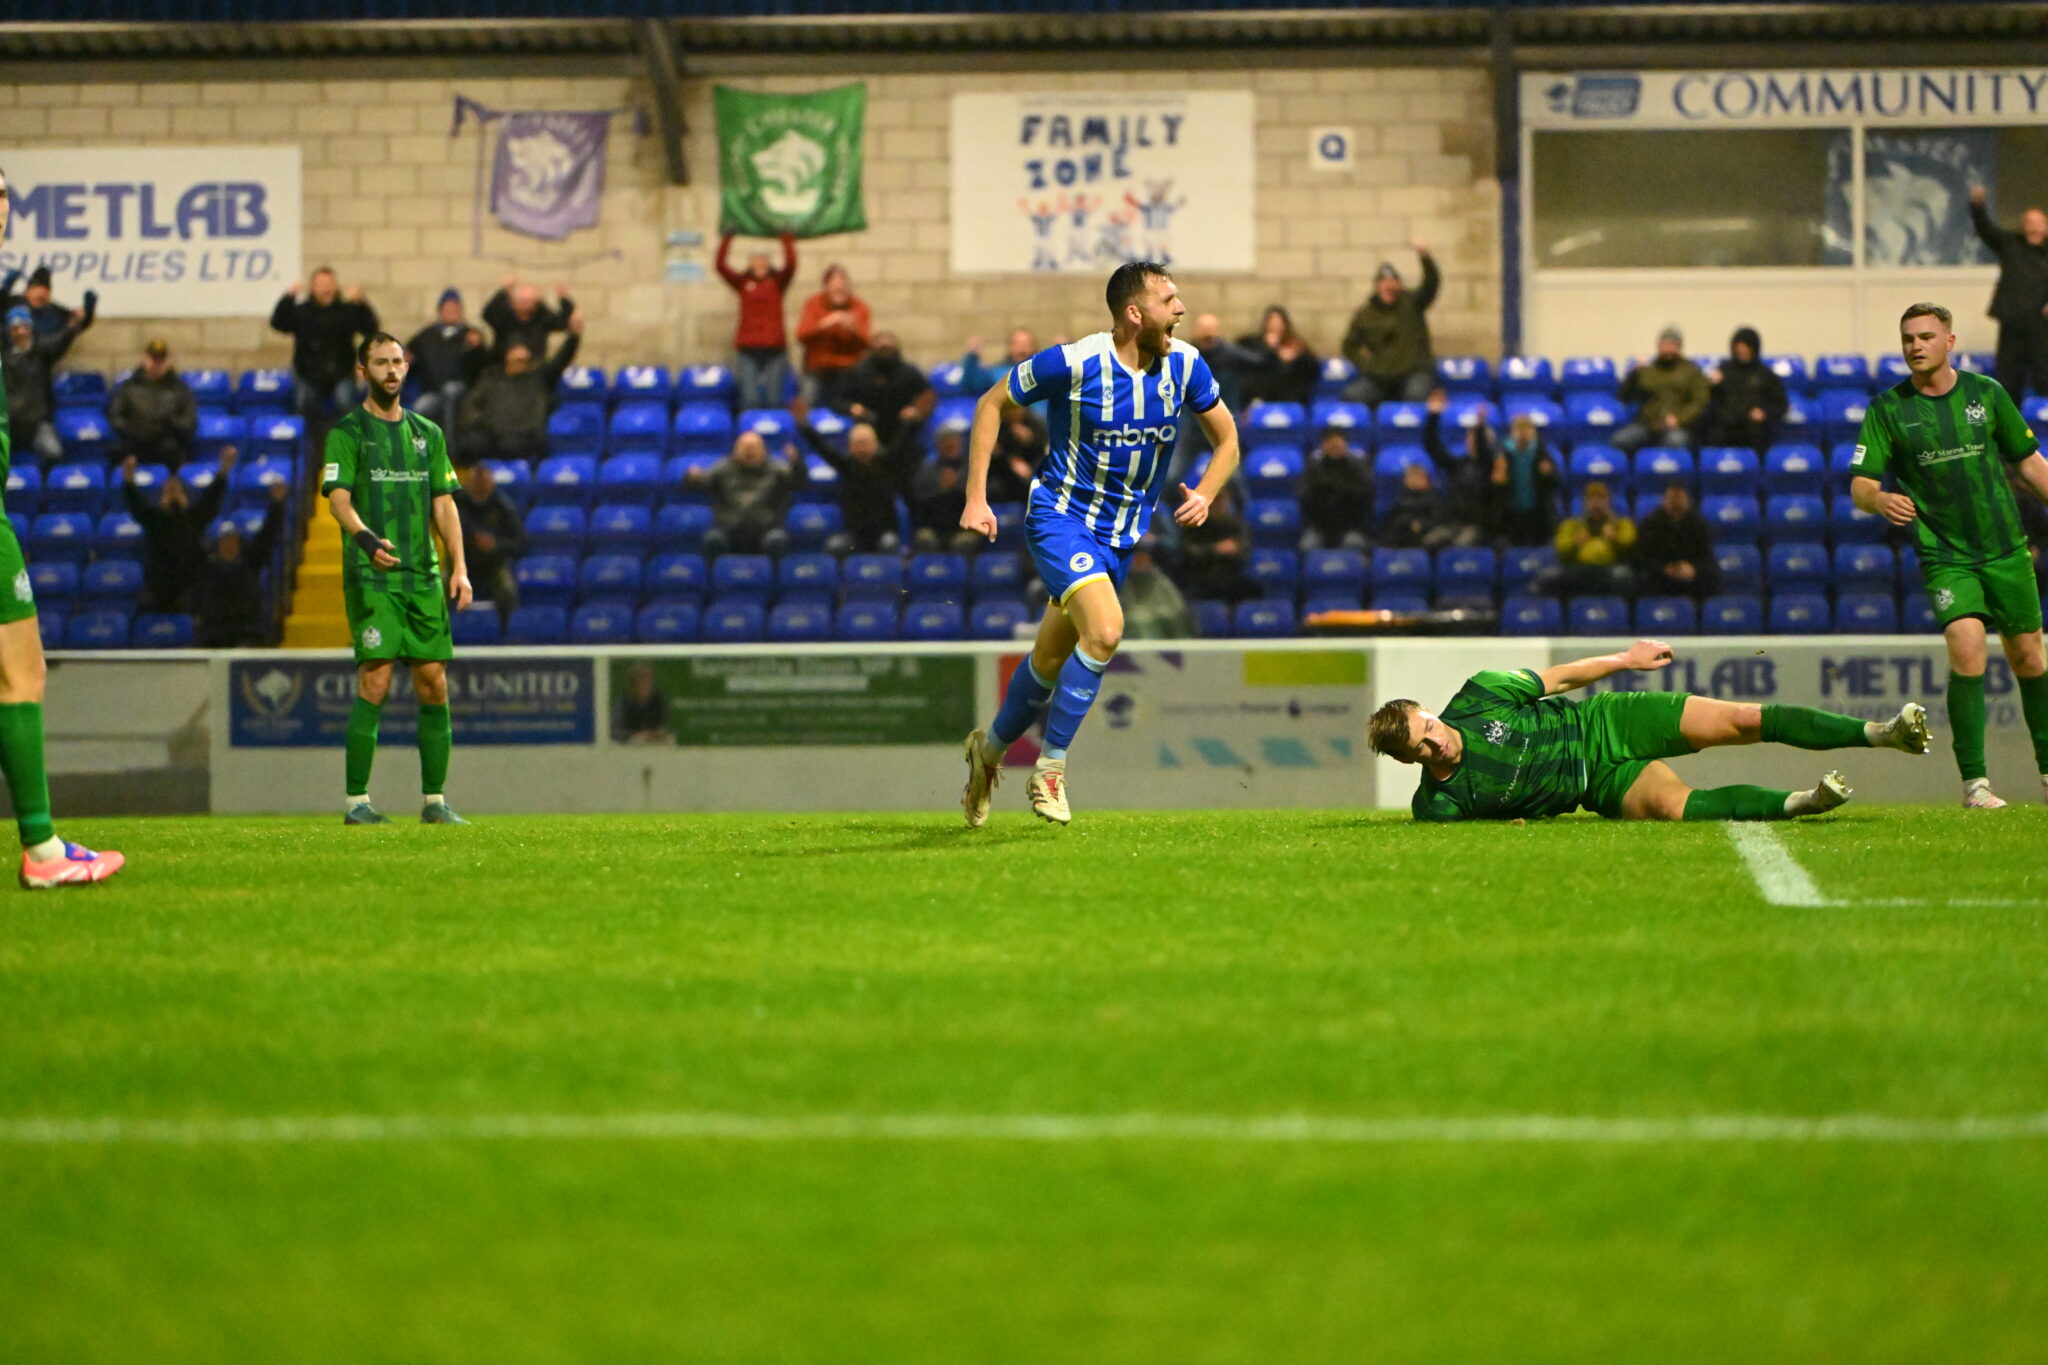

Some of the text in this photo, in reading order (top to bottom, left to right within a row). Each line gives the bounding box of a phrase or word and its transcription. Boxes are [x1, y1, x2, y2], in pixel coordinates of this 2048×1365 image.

[1672, 72, 2048, 119] COMMUNITY
[1020, 114, 1183, 147] FAMILY
[1025, 149, 1131, 189] ZONE
[4, 182, 269, 240] METLAB
[0, 251, 187, 282] SUPPLIES
[1092, 423, 1177, 448] mbna
[468, 670, 579, 698] UNITED
[1820, 655, 2015, 696] METLB
